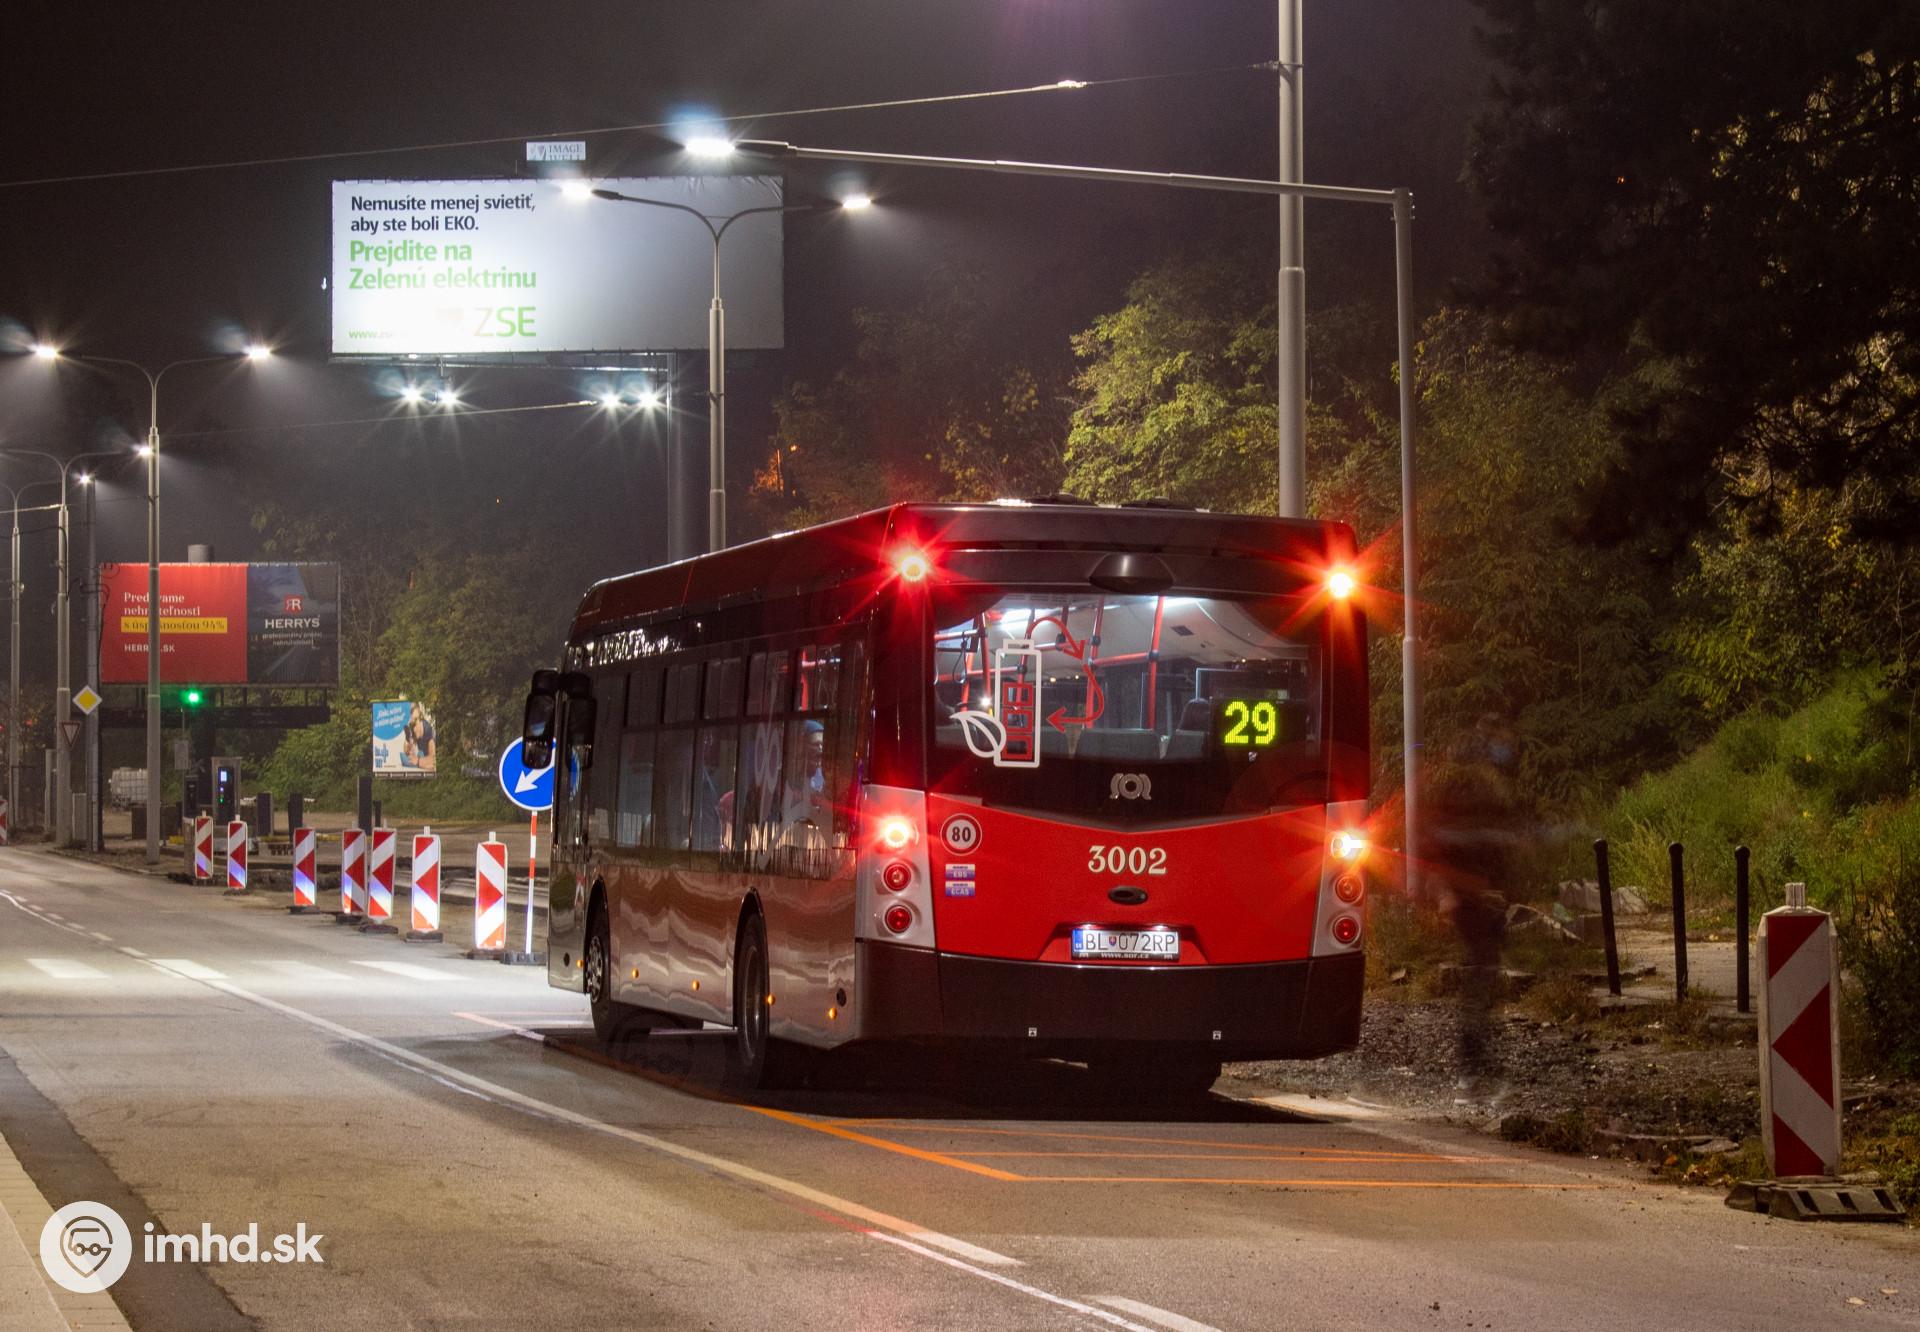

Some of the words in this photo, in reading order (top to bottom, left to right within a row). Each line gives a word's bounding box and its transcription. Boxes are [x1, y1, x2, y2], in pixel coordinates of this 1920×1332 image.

[549, 144, 582, 153] IMAGE
[351, 195, 426, 211] Nemusíte
[430, 194, 480, 213] menej
[484, 193, 536, 212] svietiť,
[350, 217, 379, 235] aby
[383, 219, 407, 231] ste
[411, 216, 439, 231] boli
[444, 215, 479, 231] EKO.
[350, 240, 437, 267] Prejdite
[444, 244, 472, 261] na
[348, 267, 426, 289] Zelenú
[433, 266, 537, 289] elektrinu
[473, 306, 537, 337] ZSE
[265, 617, 320, 629] HERRYS
[124, 644, 175, 653] HERR.SK
[1224, 701, 1276, 745] 29
[951, 826, 971, 842] 80
[1088, 845, 1168, 875] 3002
[1085, 933, 1108, 951] BL
[1118, 932, 1176, 952] 072RP
